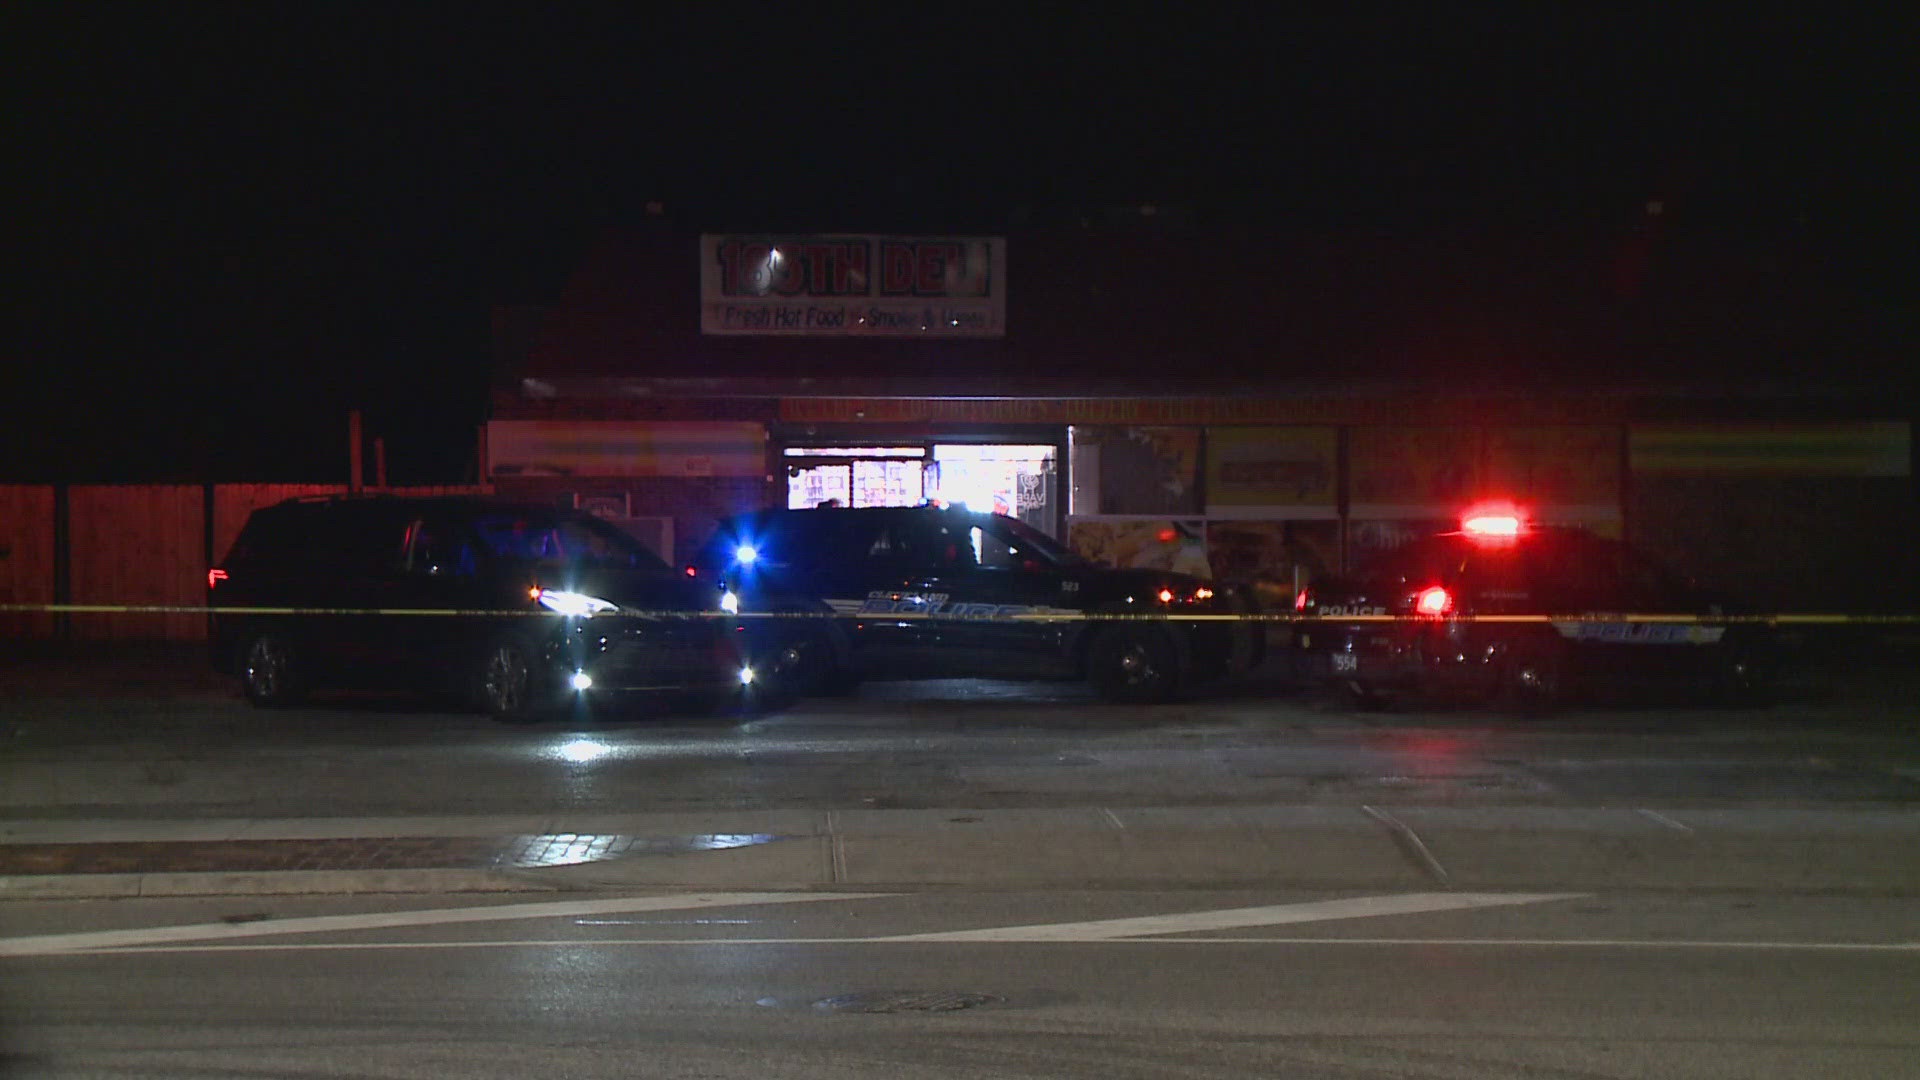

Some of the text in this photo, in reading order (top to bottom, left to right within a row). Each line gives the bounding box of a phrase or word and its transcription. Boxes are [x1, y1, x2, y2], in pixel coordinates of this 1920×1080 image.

[880, 240, 991, 297] DELI
[725, 306, 770, 326] Fresh
[775, 306, 801, 326] Hot
[806, 305, 846, 327] Food
[1318, 605, 1386, 618] POLICE
